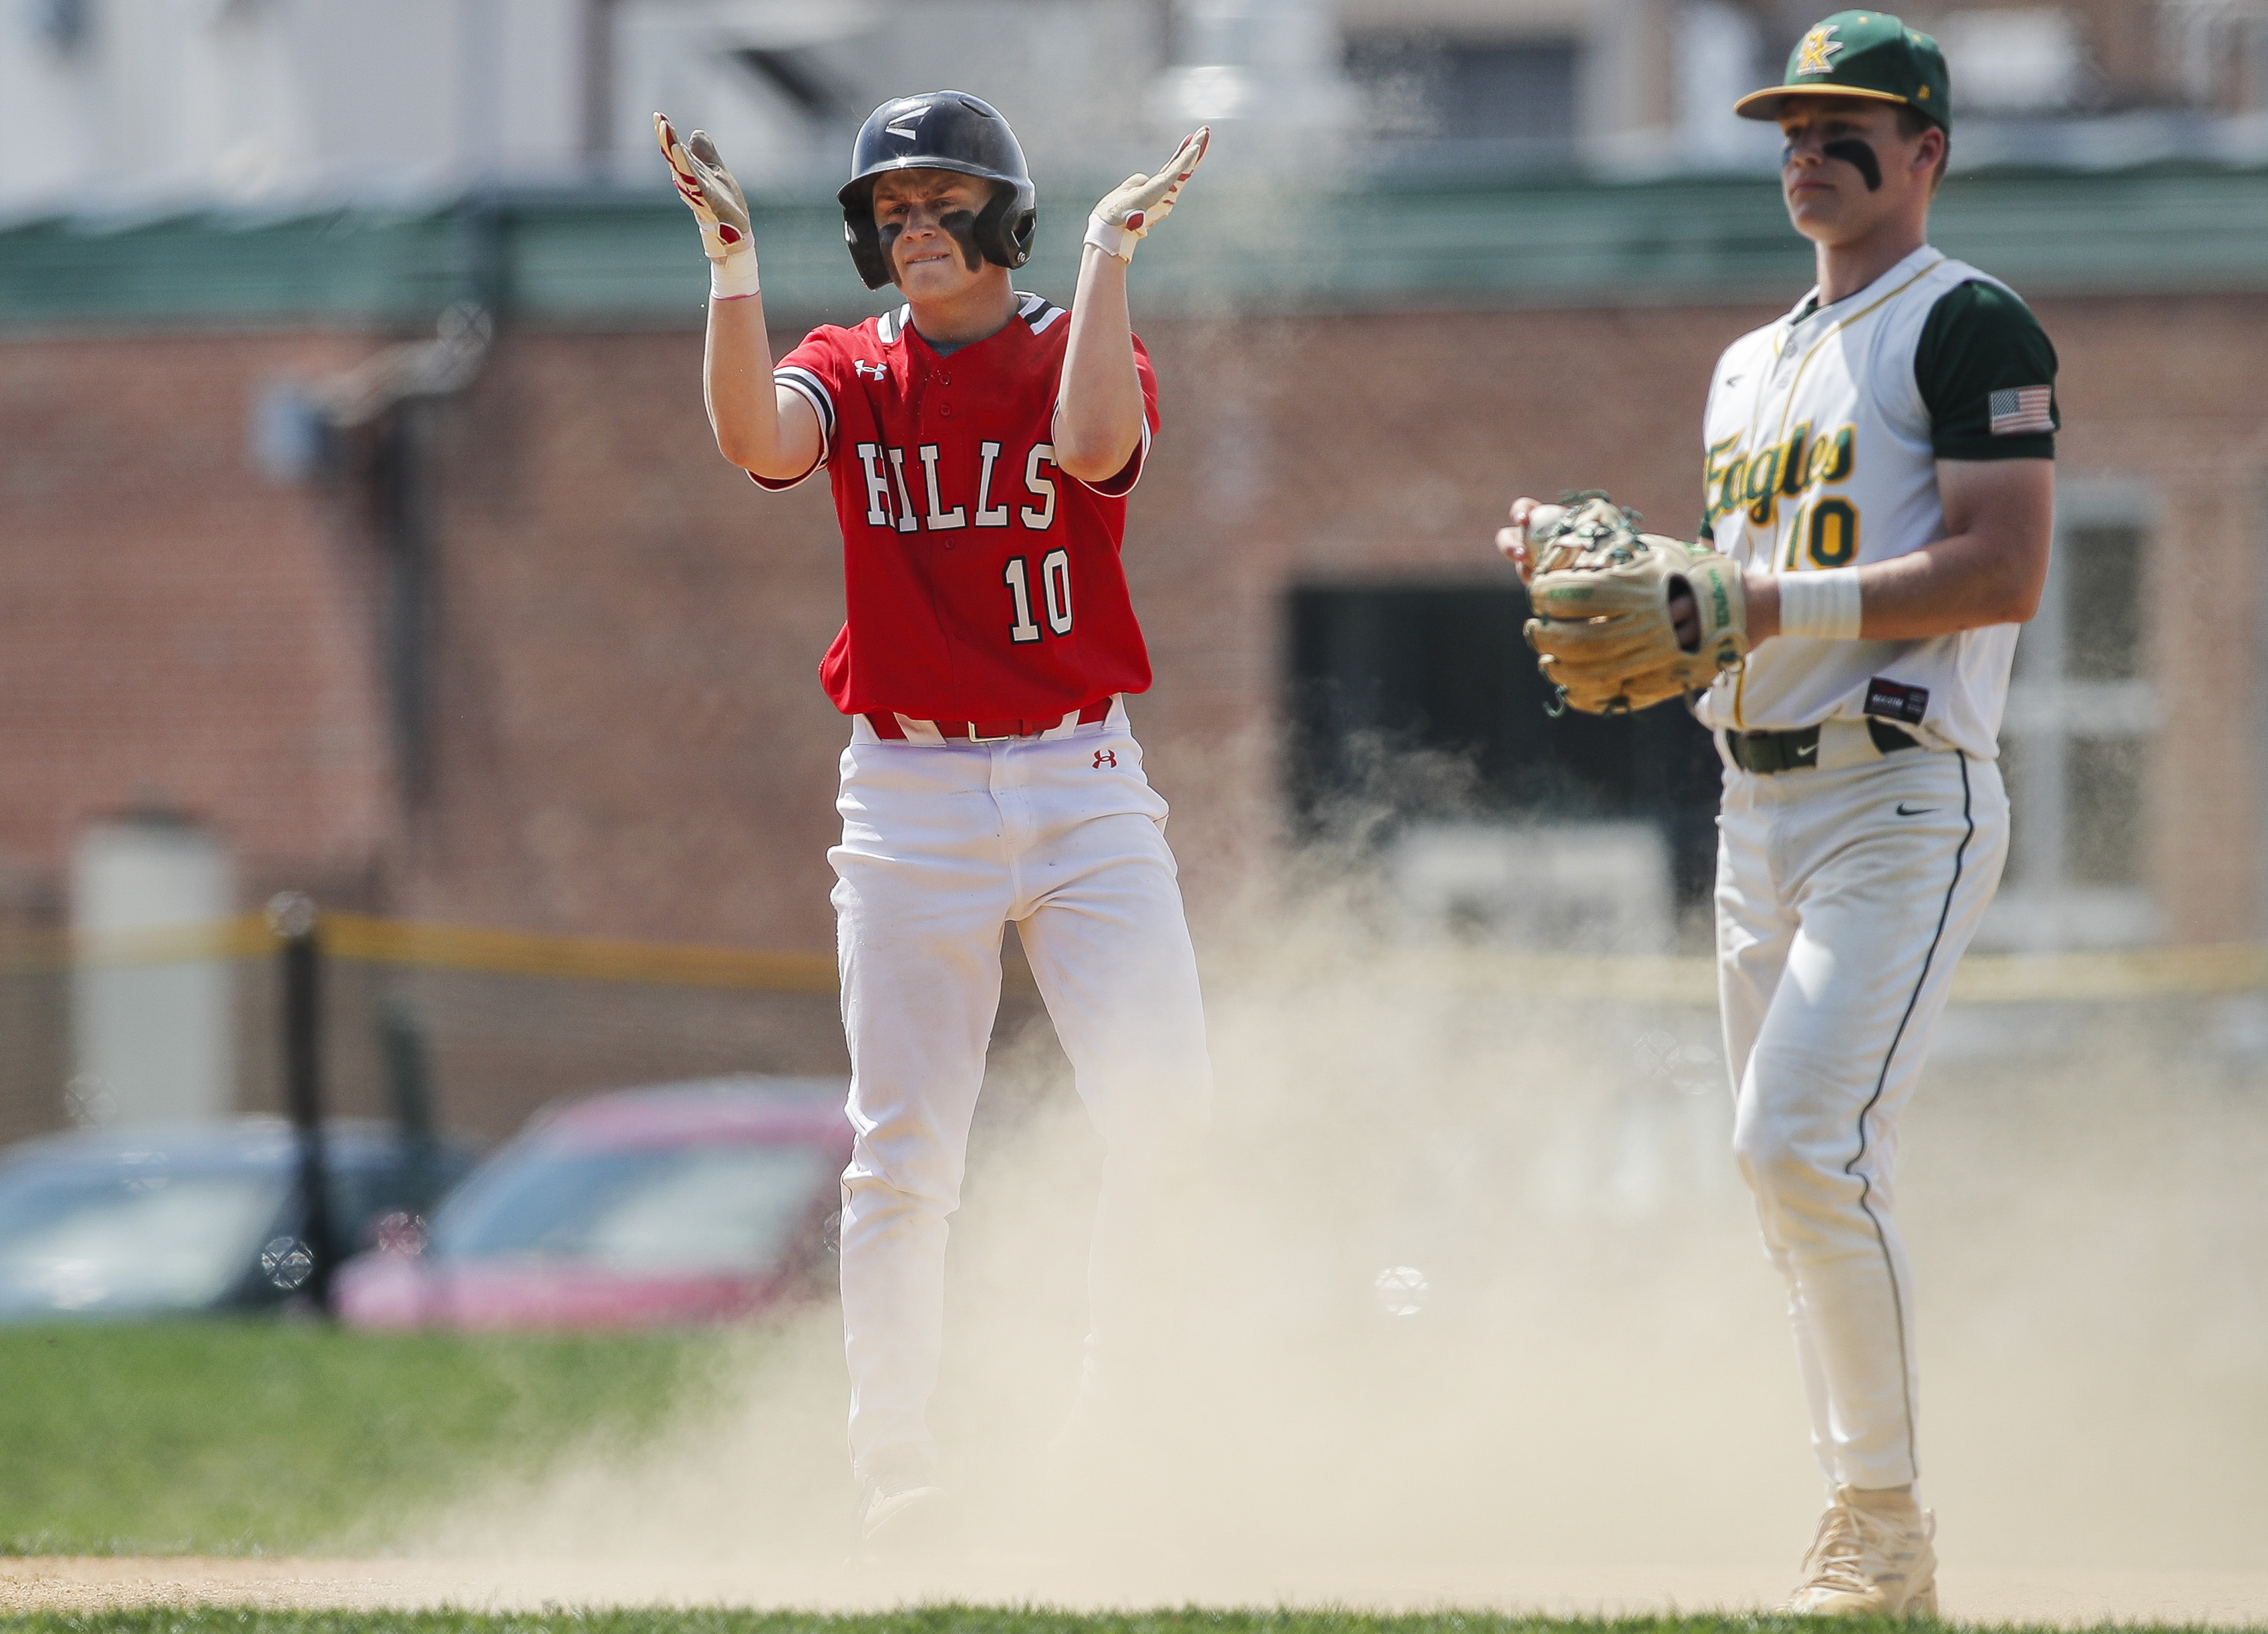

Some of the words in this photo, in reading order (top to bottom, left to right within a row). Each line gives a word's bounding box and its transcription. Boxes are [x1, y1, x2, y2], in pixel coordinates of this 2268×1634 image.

[856, 440, 1058, 534] HILLS
[1703, 419, 1856, 528] Eagles
[1783, 495, 1860, 571] 10
[1003, 545, 1074, 645] 10
